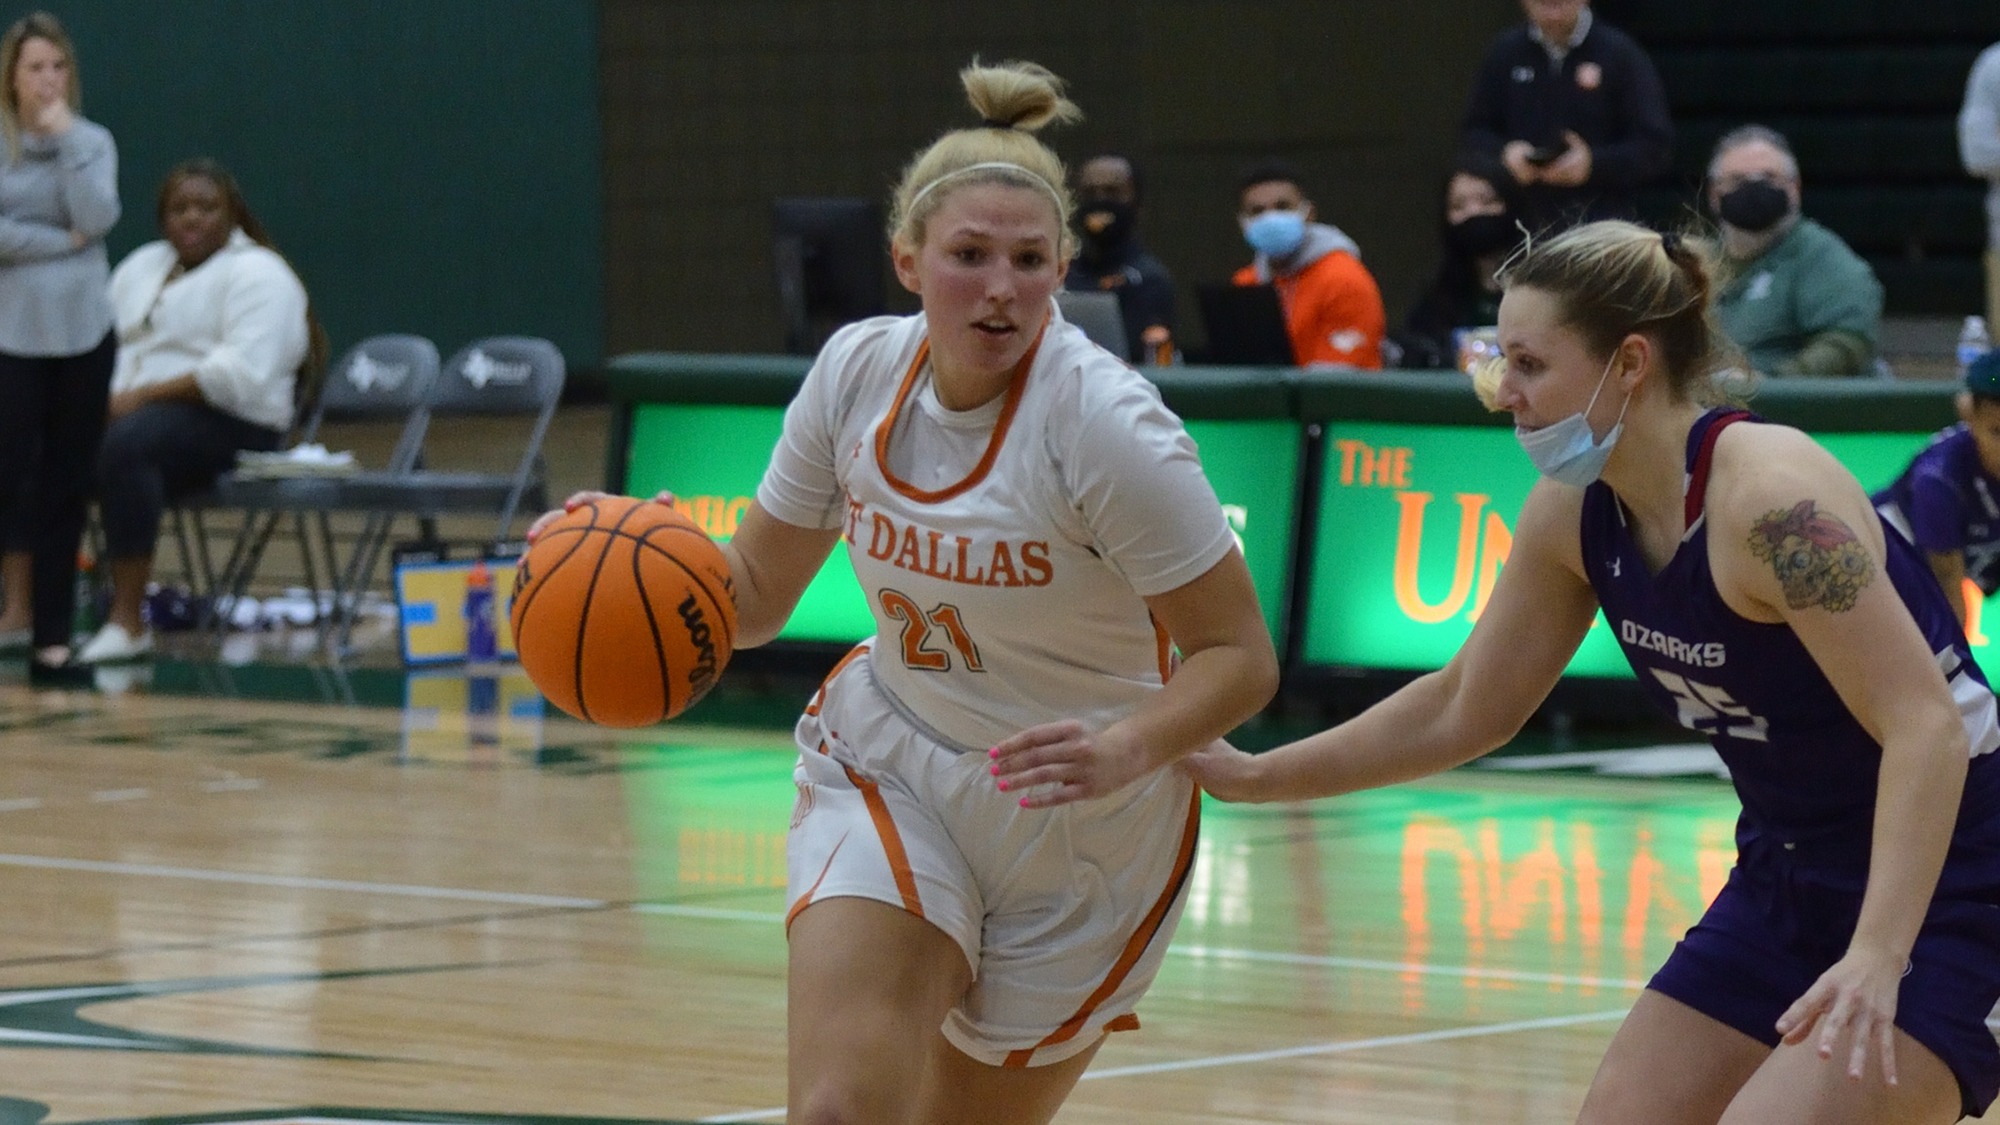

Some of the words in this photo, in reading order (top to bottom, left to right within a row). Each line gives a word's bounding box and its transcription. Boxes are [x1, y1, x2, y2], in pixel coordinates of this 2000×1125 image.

[1336, 438, 1414, 488] THE
[867, 511, 1054, 588] DALLAS
[878, 587, 988, 673] 21
[1621, 618, 1727, 669] OZARKS
[1649, 666, 1771, 743] 25
